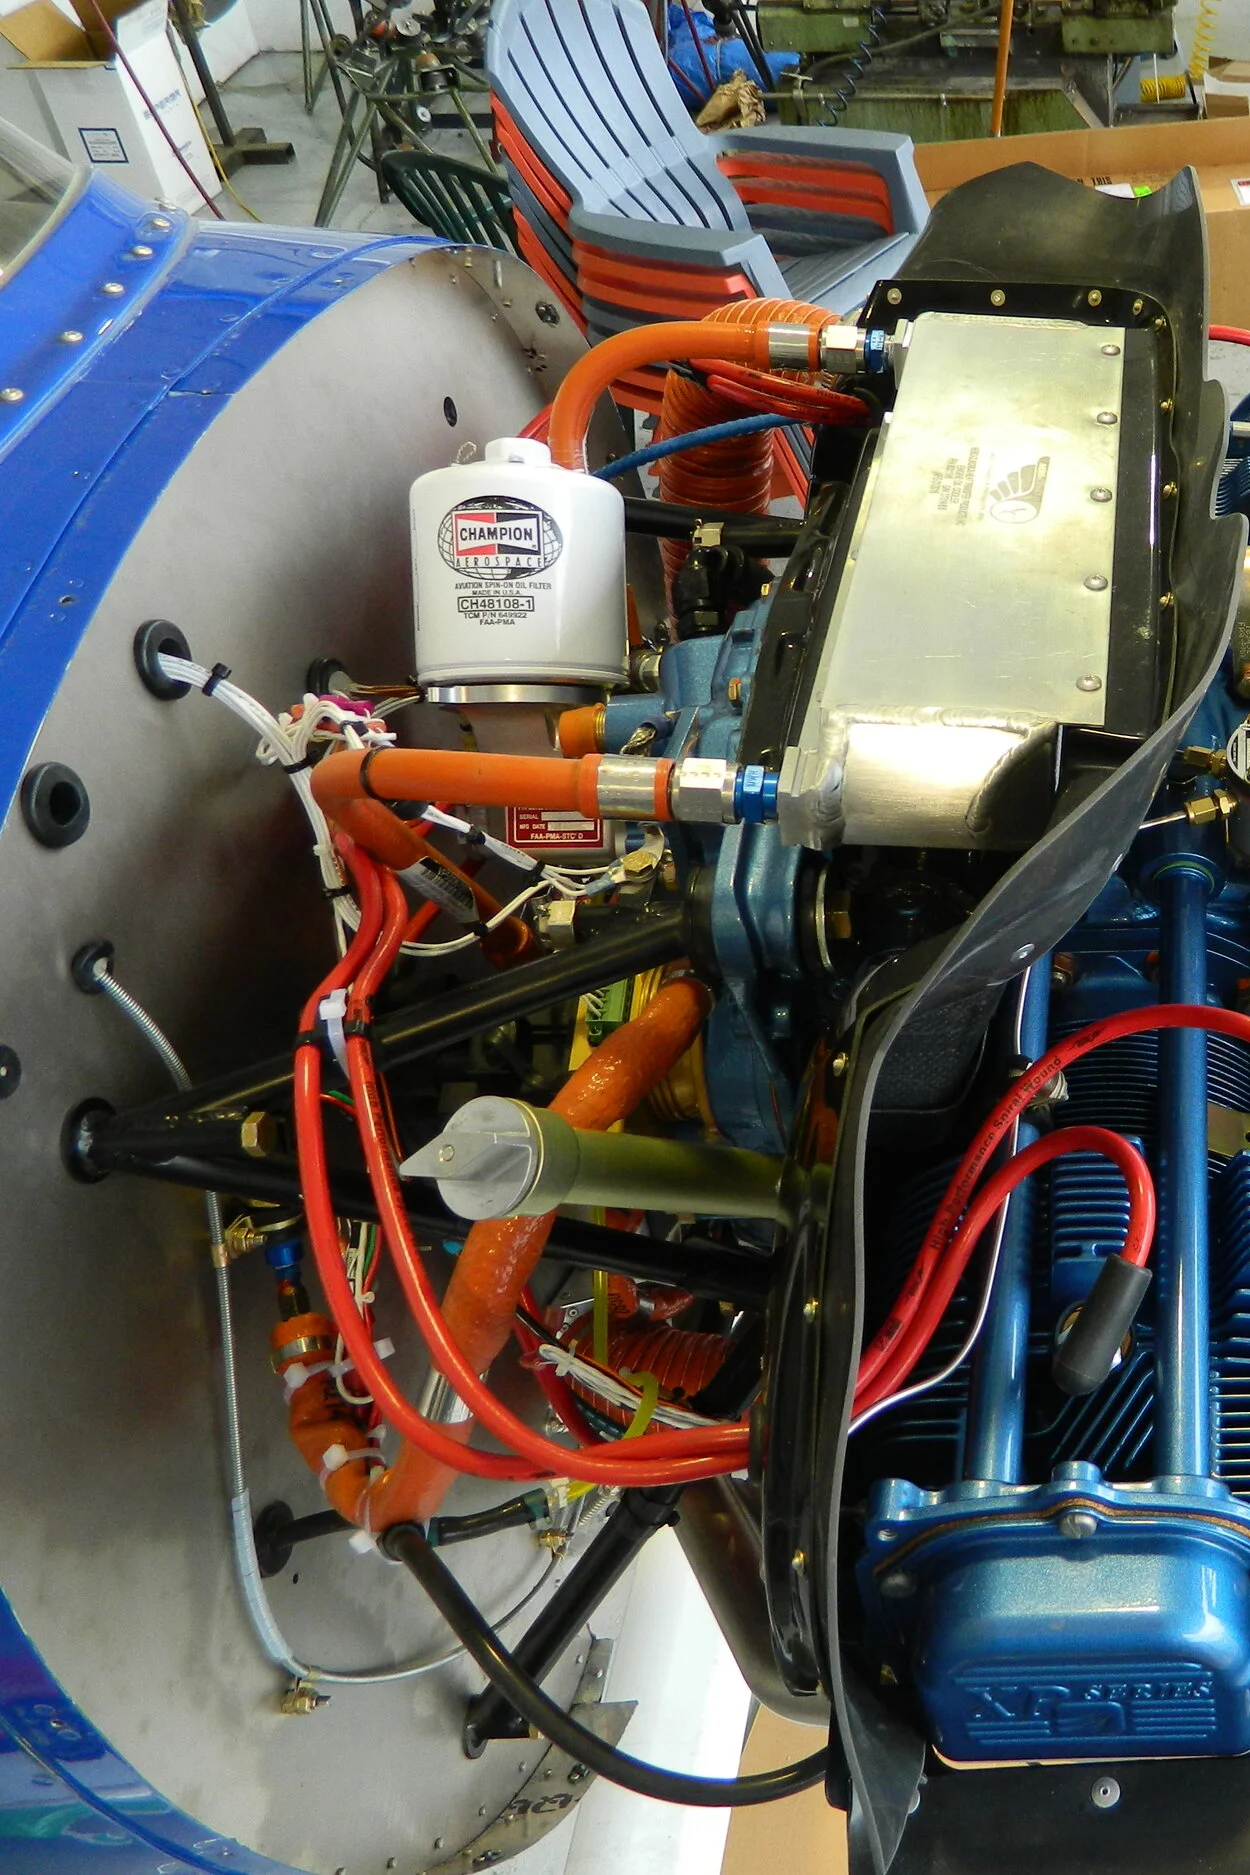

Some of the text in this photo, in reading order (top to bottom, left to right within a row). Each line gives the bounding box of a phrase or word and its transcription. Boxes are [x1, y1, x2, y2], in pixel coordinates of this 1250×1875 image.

[460, 527, 533, 541] CHAMPION
[456, 556, 542, 568] AEROSPACE
[455, 581, 552, 590] AVIATION SPIN-ON OIL FILTER
[460, 598, 532, 610] CH48108-1
[479, 618, 515, 626] FAA-PMA
[946, 1131, 996, 1215] Performance
[993, 1094, 1022, 1130] Spiral
[1021, 1056, 1062, 1092] Wound
[1083, 1681, 1214, 1701] SERIES
